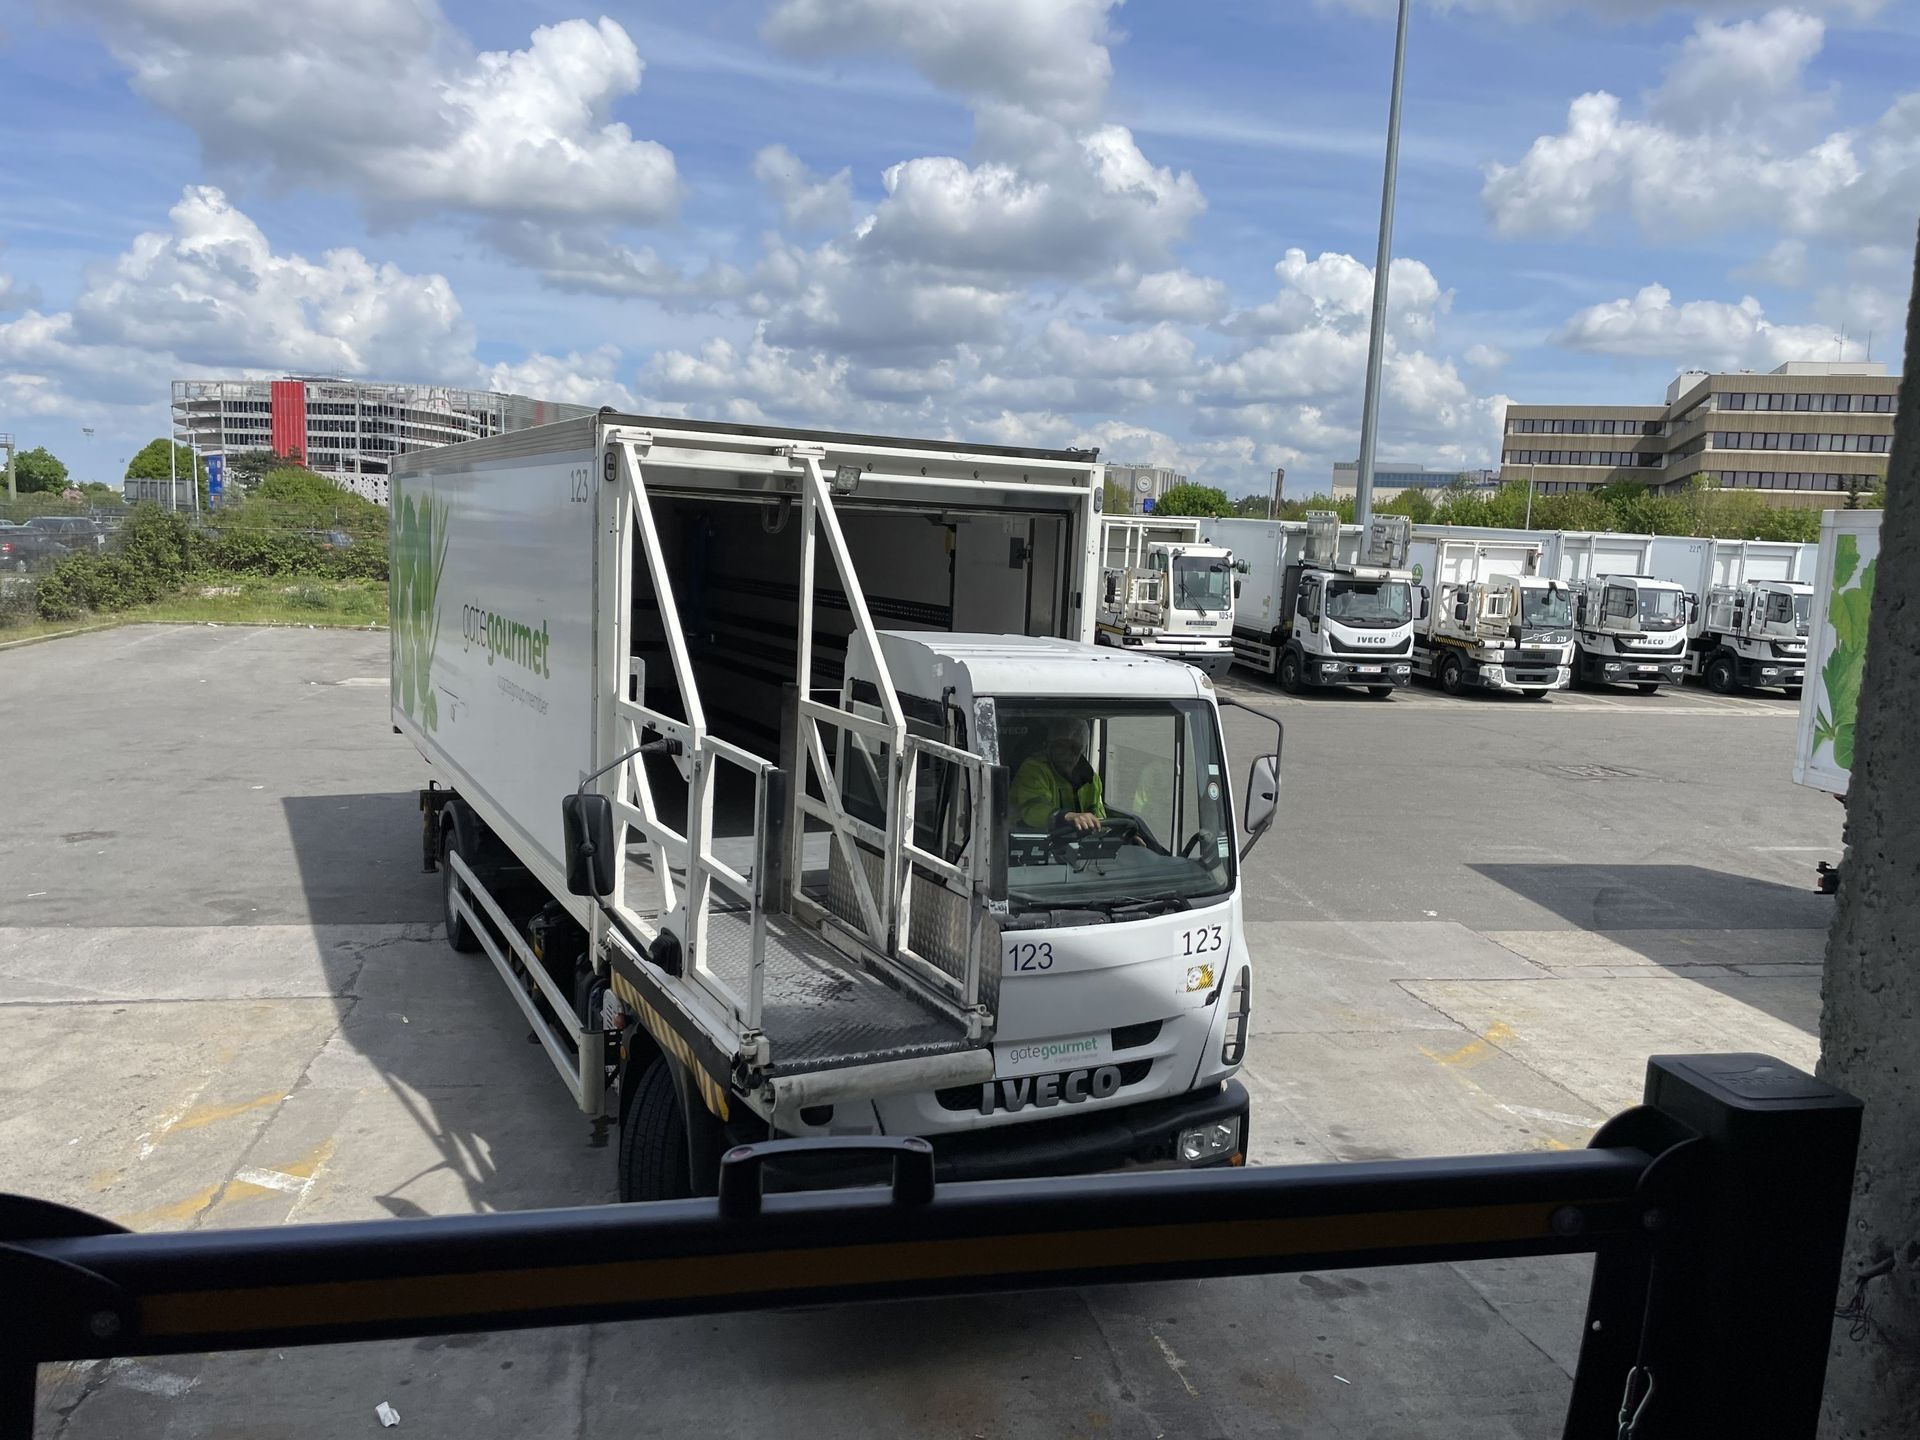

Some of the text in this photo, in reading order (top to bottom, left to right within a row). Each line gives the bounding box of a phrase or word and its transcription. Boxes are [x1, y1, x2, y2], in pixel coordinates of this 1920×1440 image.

[570, 469, 588, 503] 123
[1182, 926, 1222, 956] 123
[1009, 942, 1053, 971] 123
[1010, 1038, 1098, 1064] gategourmet
[980, 1065, 1121, 1115] IVECO
